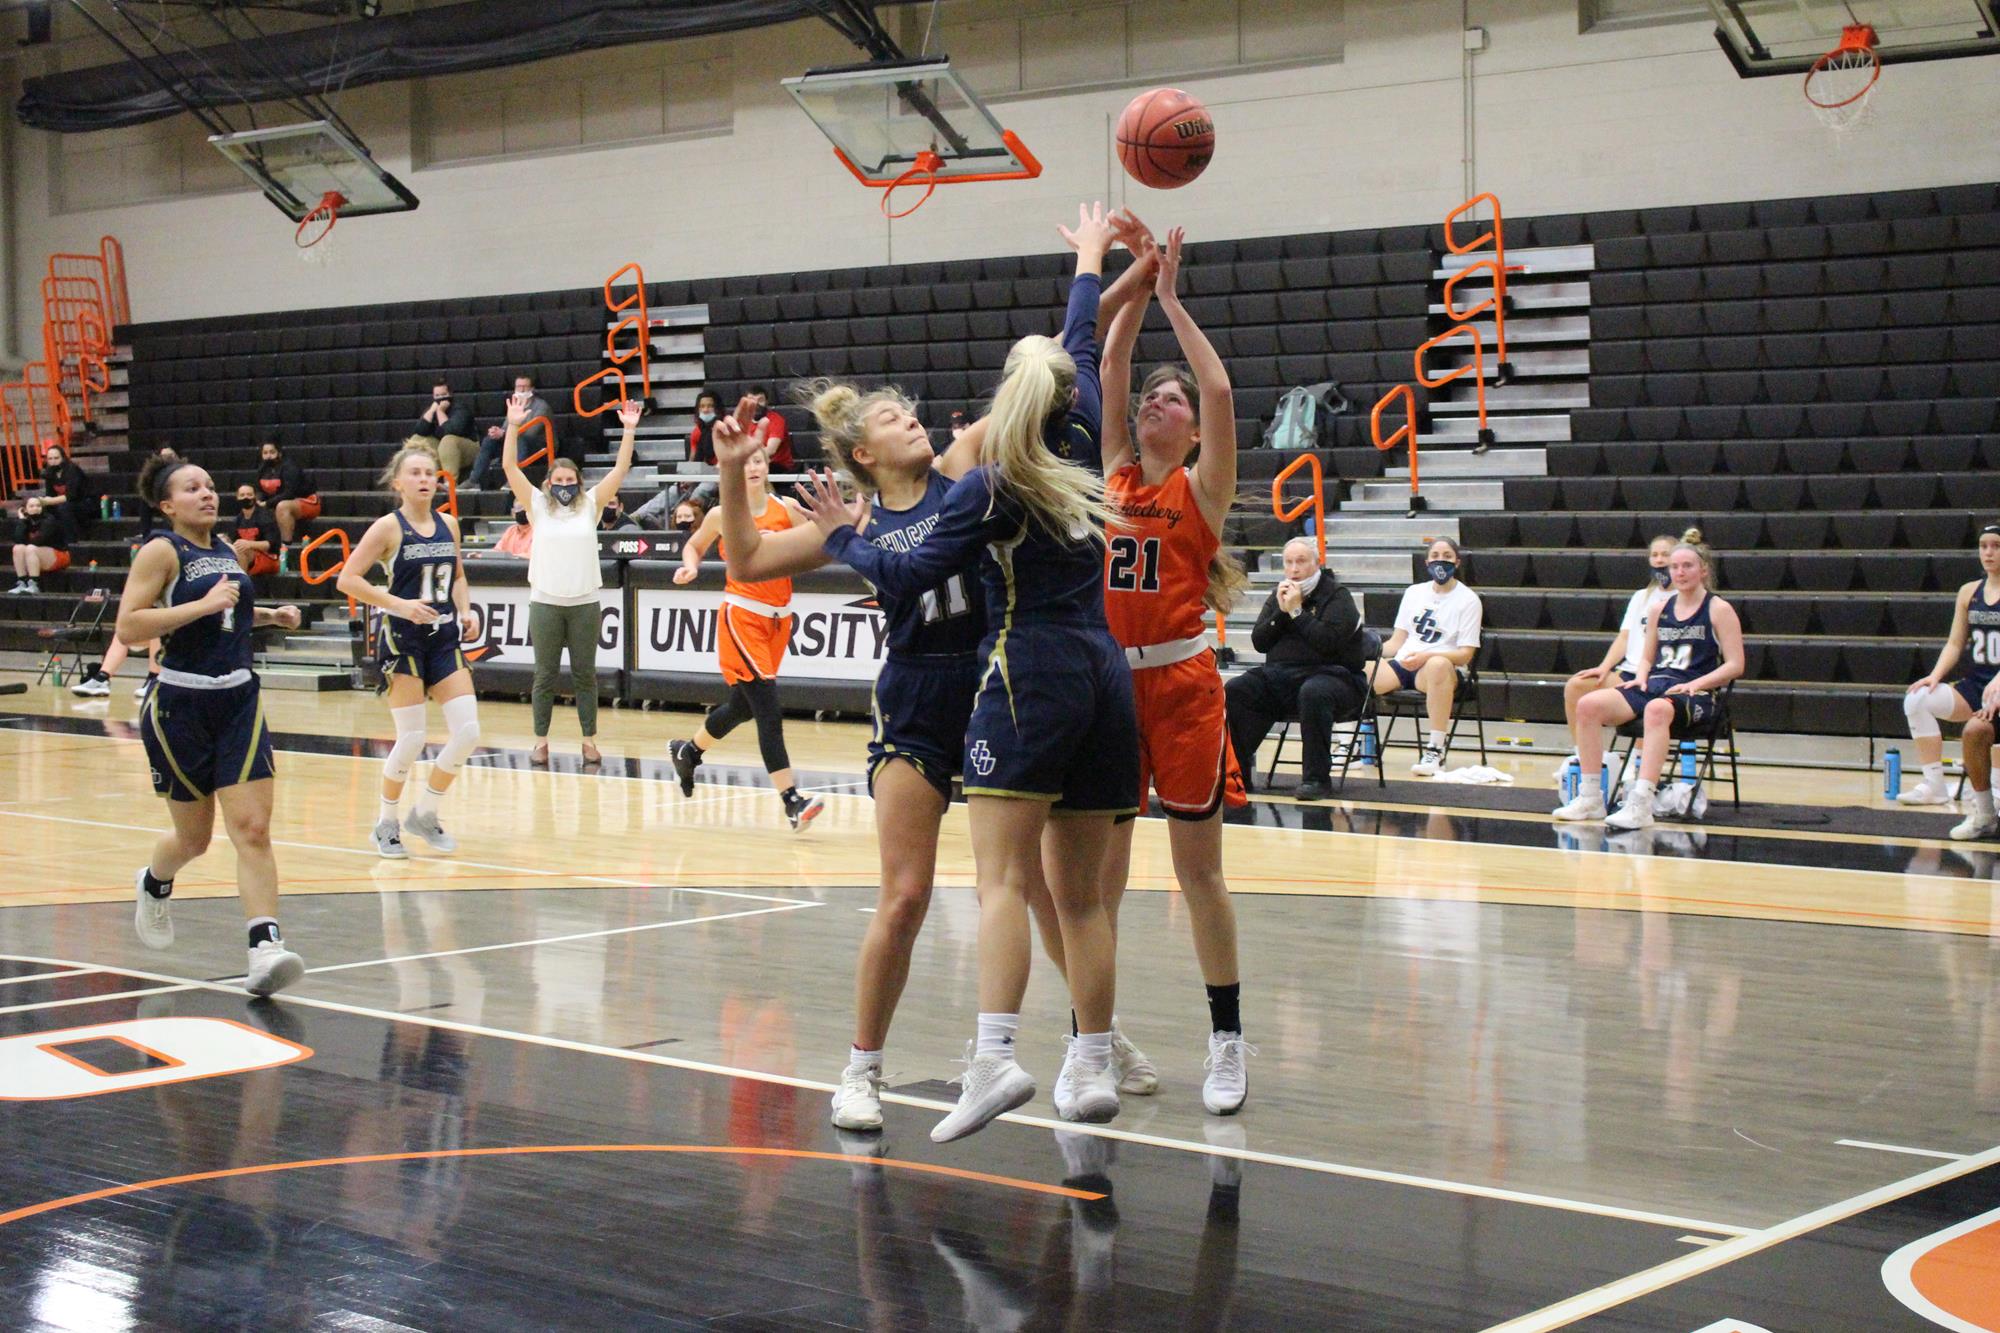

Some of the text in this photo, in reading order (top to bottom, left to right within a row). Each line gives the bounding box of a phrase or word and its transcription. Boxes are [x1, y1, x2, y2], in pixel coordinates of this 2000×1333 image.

[619, 541, 639, 552] POSS
[1108, 535, 1160, 592] 21
[183, 557, 215, 582] JOHN
[419, 562, 453, 603] 13
[650, 607, 890, 660] UNISITY
[1971, 628, 2000, 666] 20
